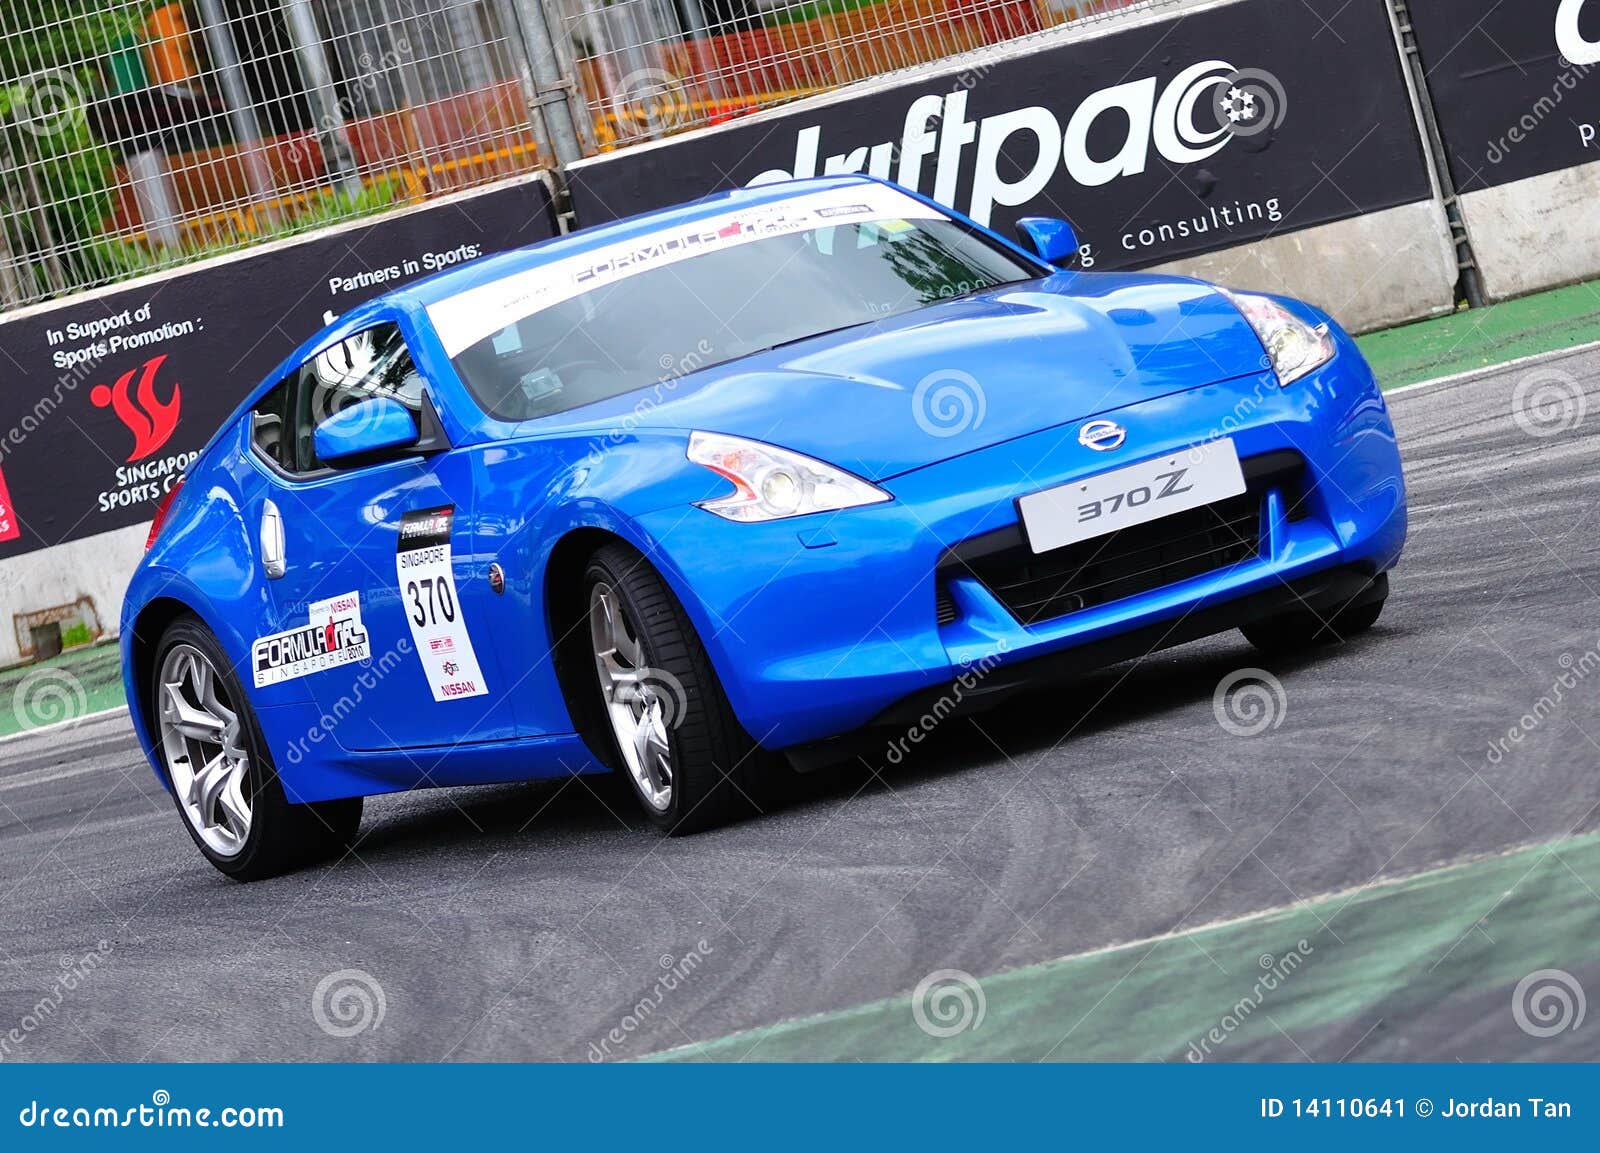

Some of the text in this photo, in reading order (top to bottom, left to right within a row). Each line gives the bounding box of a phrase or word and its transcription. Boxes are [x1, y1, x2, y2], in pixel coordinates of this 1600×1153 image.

[743, 59, 1238, 228] ftpac
[1122, 198, 1282, 250] consulting
[329, 243, 483, 295] Partners in Sports:
[47, 302, 152, 346] In Support of
[53, 344, 108, 370] Sports
[109, 319, 194, 354] Promotion
[115, 450, 204, 487] SINGAPOR
[98, 482, 160, 512] SPORTS
[401, 547, 445, 569] SINGAPORE
[330, 597, 357, 614] NISSAN
[407, 575, 455, 628] 370
[347, 645, 365, 661] 2010
[440, 680, 477, 697] NISSAN
